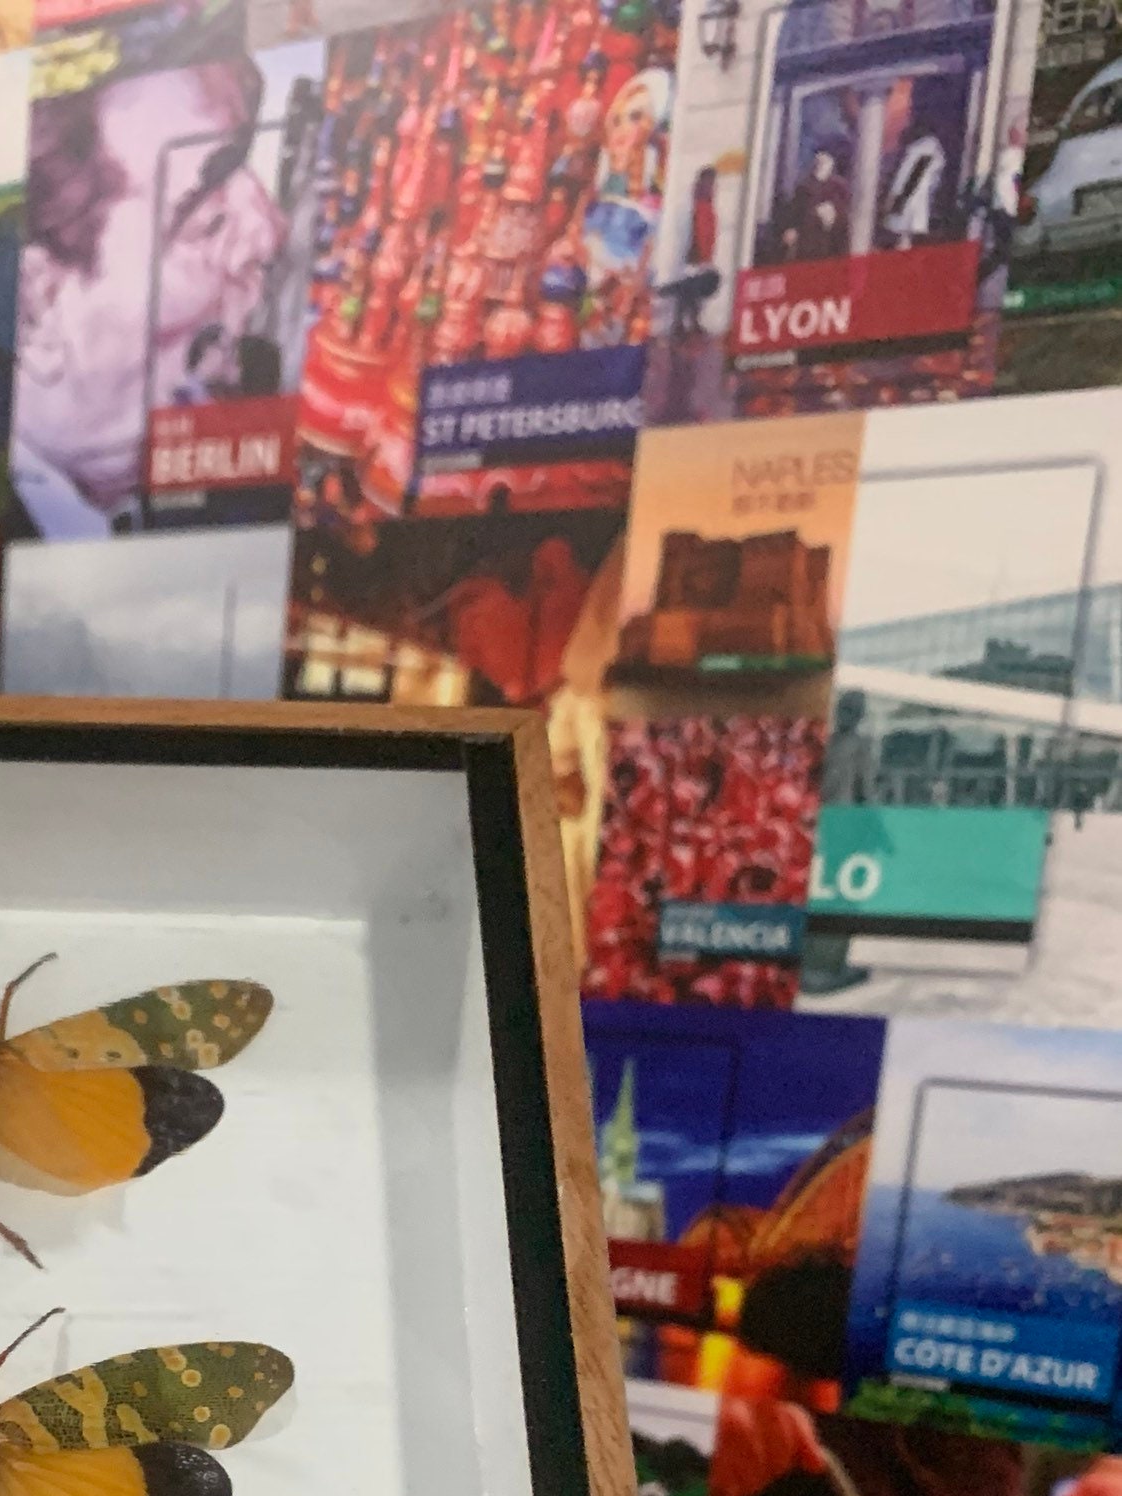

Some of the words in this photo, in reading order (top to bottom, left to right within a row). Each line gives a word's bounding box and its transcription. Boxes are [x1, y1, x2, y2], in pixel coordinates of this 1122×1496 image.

[739, 297, 852, 344] LYON
[423, 414, 457, 446] ST
[150, 434, 281, 485] BERLIN
[732, 451, 858, 489] NAPLES
